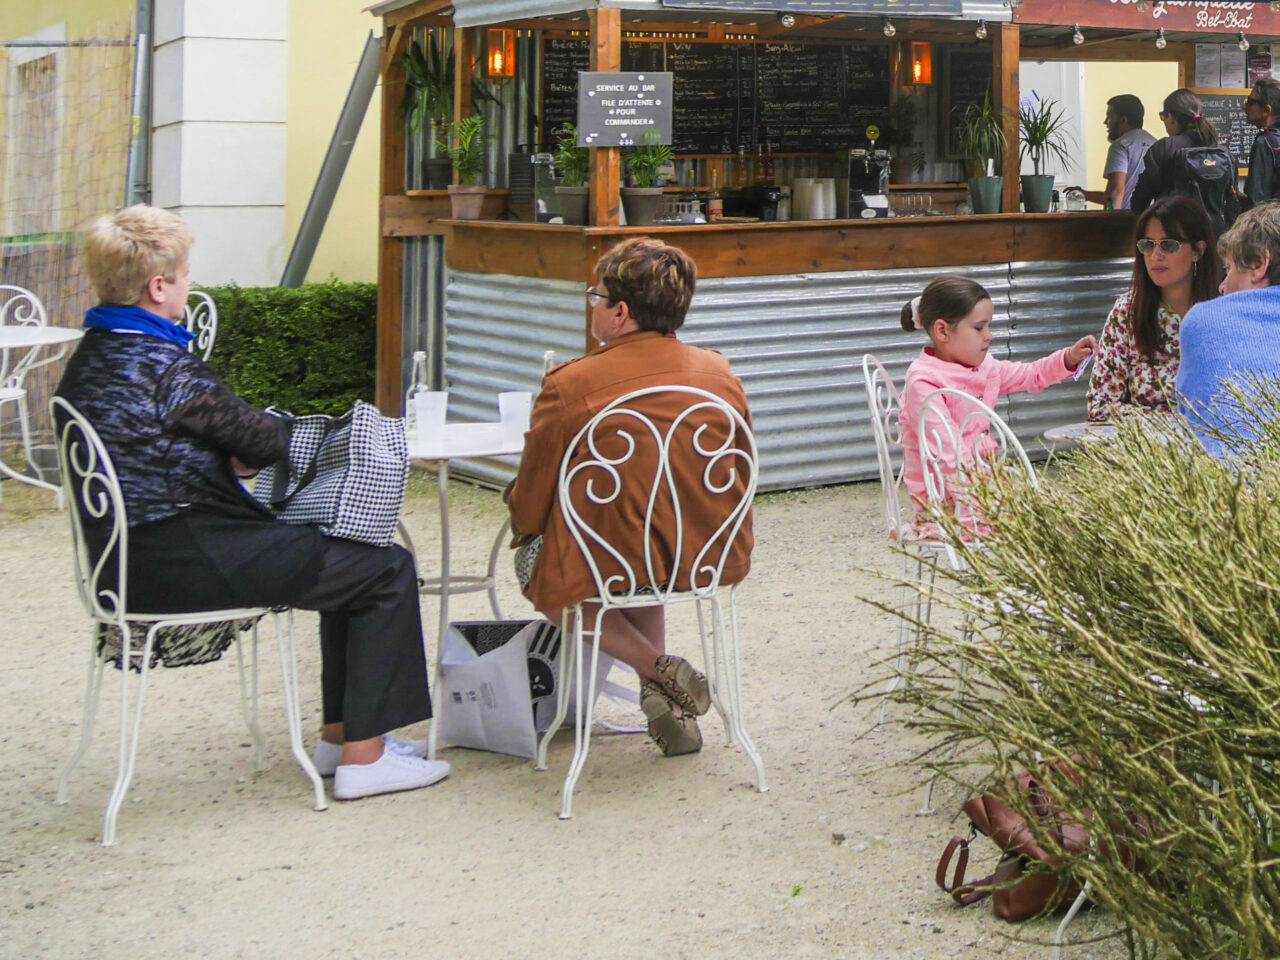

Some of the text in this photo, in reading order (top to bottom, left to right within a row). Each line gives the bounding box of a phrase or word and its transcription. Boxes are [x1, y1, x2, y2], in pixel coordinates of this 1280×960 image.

[596, 84, 656, 92] SERVICE AU BAR
[601, 99, 616, 107] FILE
[604, 118, 648, 126] COMMANDER
